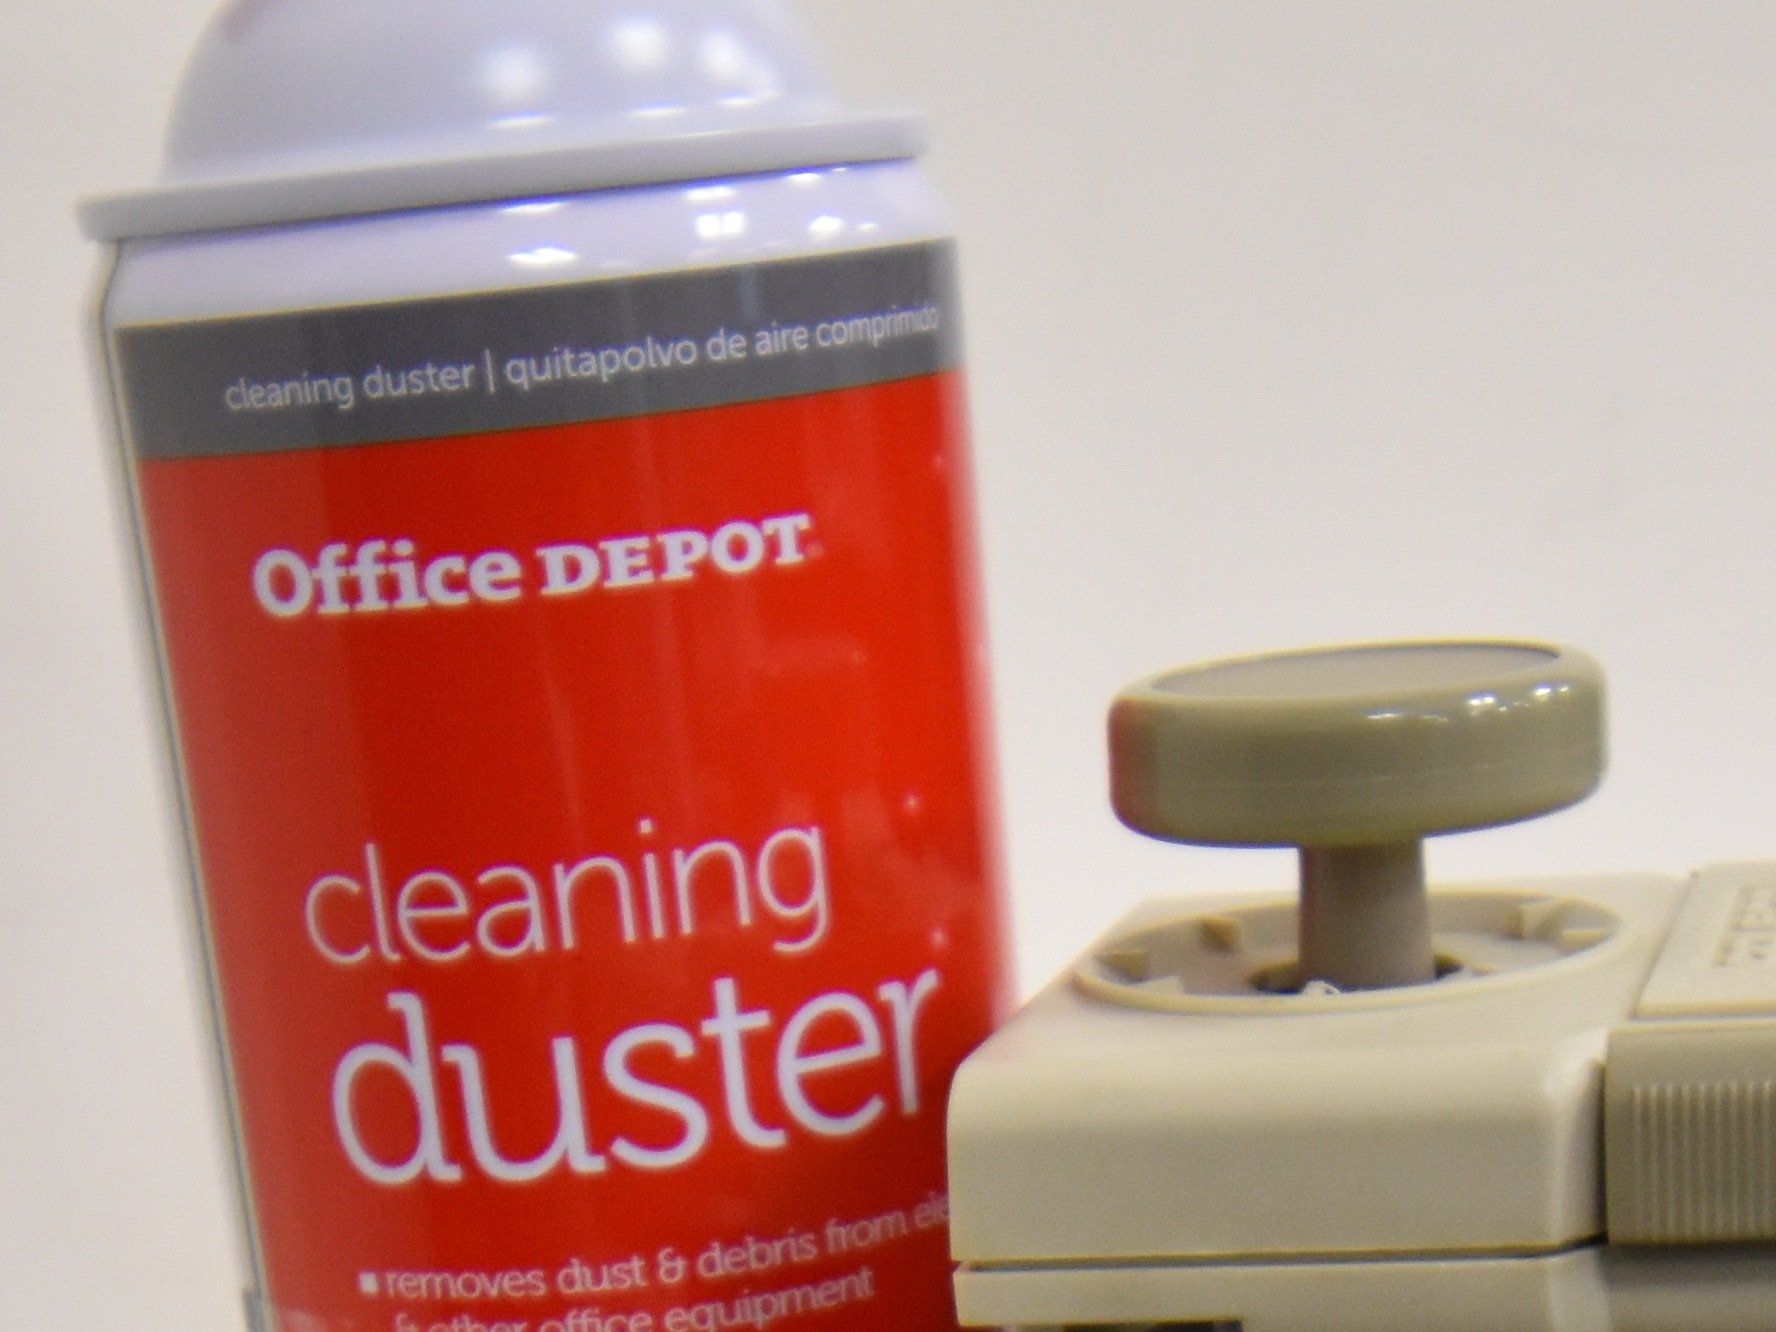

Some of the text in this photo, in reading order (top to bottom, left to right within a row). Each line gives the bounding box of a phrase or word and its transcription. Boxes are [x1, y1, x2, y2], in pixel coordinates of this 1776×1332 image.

[225, 374, 354, 410] cleaning
[363, 364, 473, 398] duster
[505, 334, 698, 391] quitapolvo
[706, 327, 746, 361] de
[755, 319, 809, 356] aire
[253, 512, 810, 616] Office DEPOT
[305, 817, 829, 964] cleaning
[332, 968, 940, 1184] duster
[385, 1269, 545, 1298] removes
[557, 1258, 647, 1294] dust
[658, 1247, 685, 1283] &
[697, 1228, 818, 1279] debris
[825, 1207, 907, 1254] from
